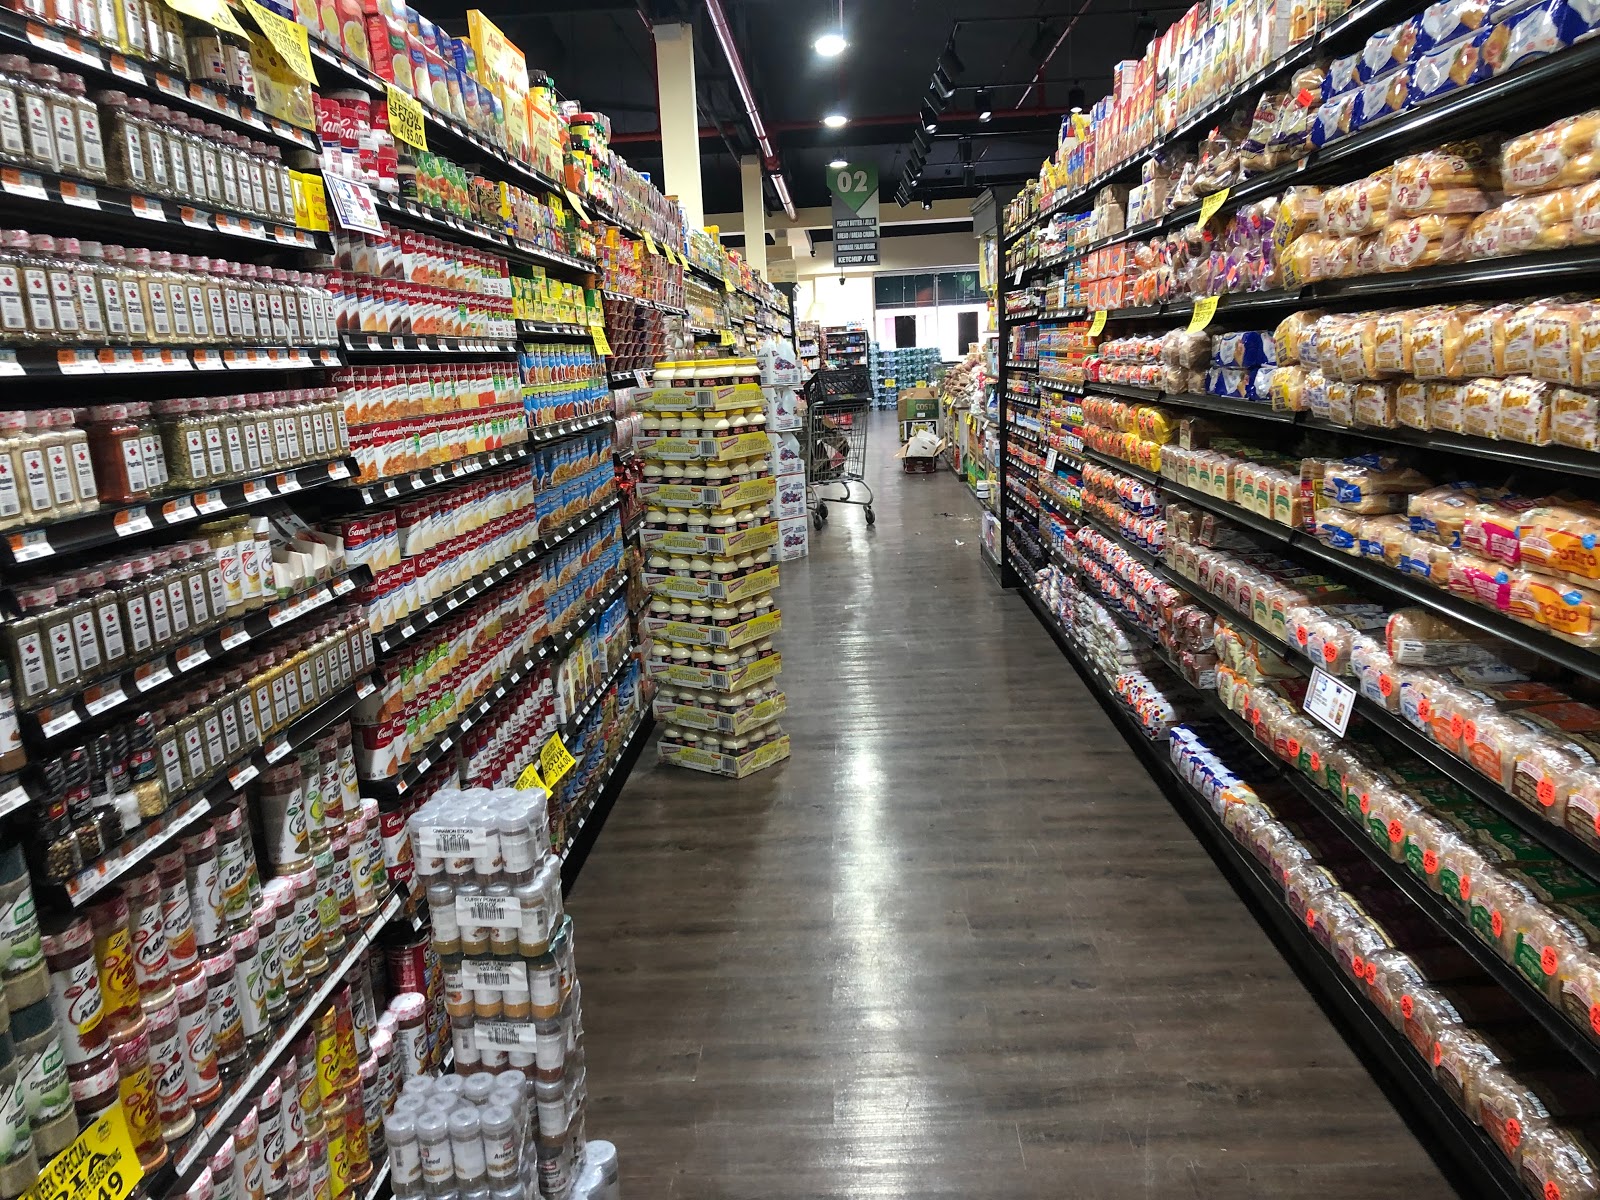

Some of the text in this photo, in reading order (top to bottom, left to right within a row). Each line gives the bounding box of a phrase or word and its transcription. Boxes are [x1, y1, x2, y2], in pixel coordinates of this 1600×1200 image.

[388, 100, 419, 124] LIPTON
[389, 107, 422, 131] SOUP
[399, 123, 424, 147] 4/$5.00
[837, 170, 868, 193] 02
[1513, 169, 1519, 181] 8
[838, 255, 862, 264] KETCHUP
[867, 254, 876, 262] OIL
[915, 402, 935, 411] COSTA
[229, 862, 244, 877] Bay
[54, 1139, 91, 1184] SPECIAL
